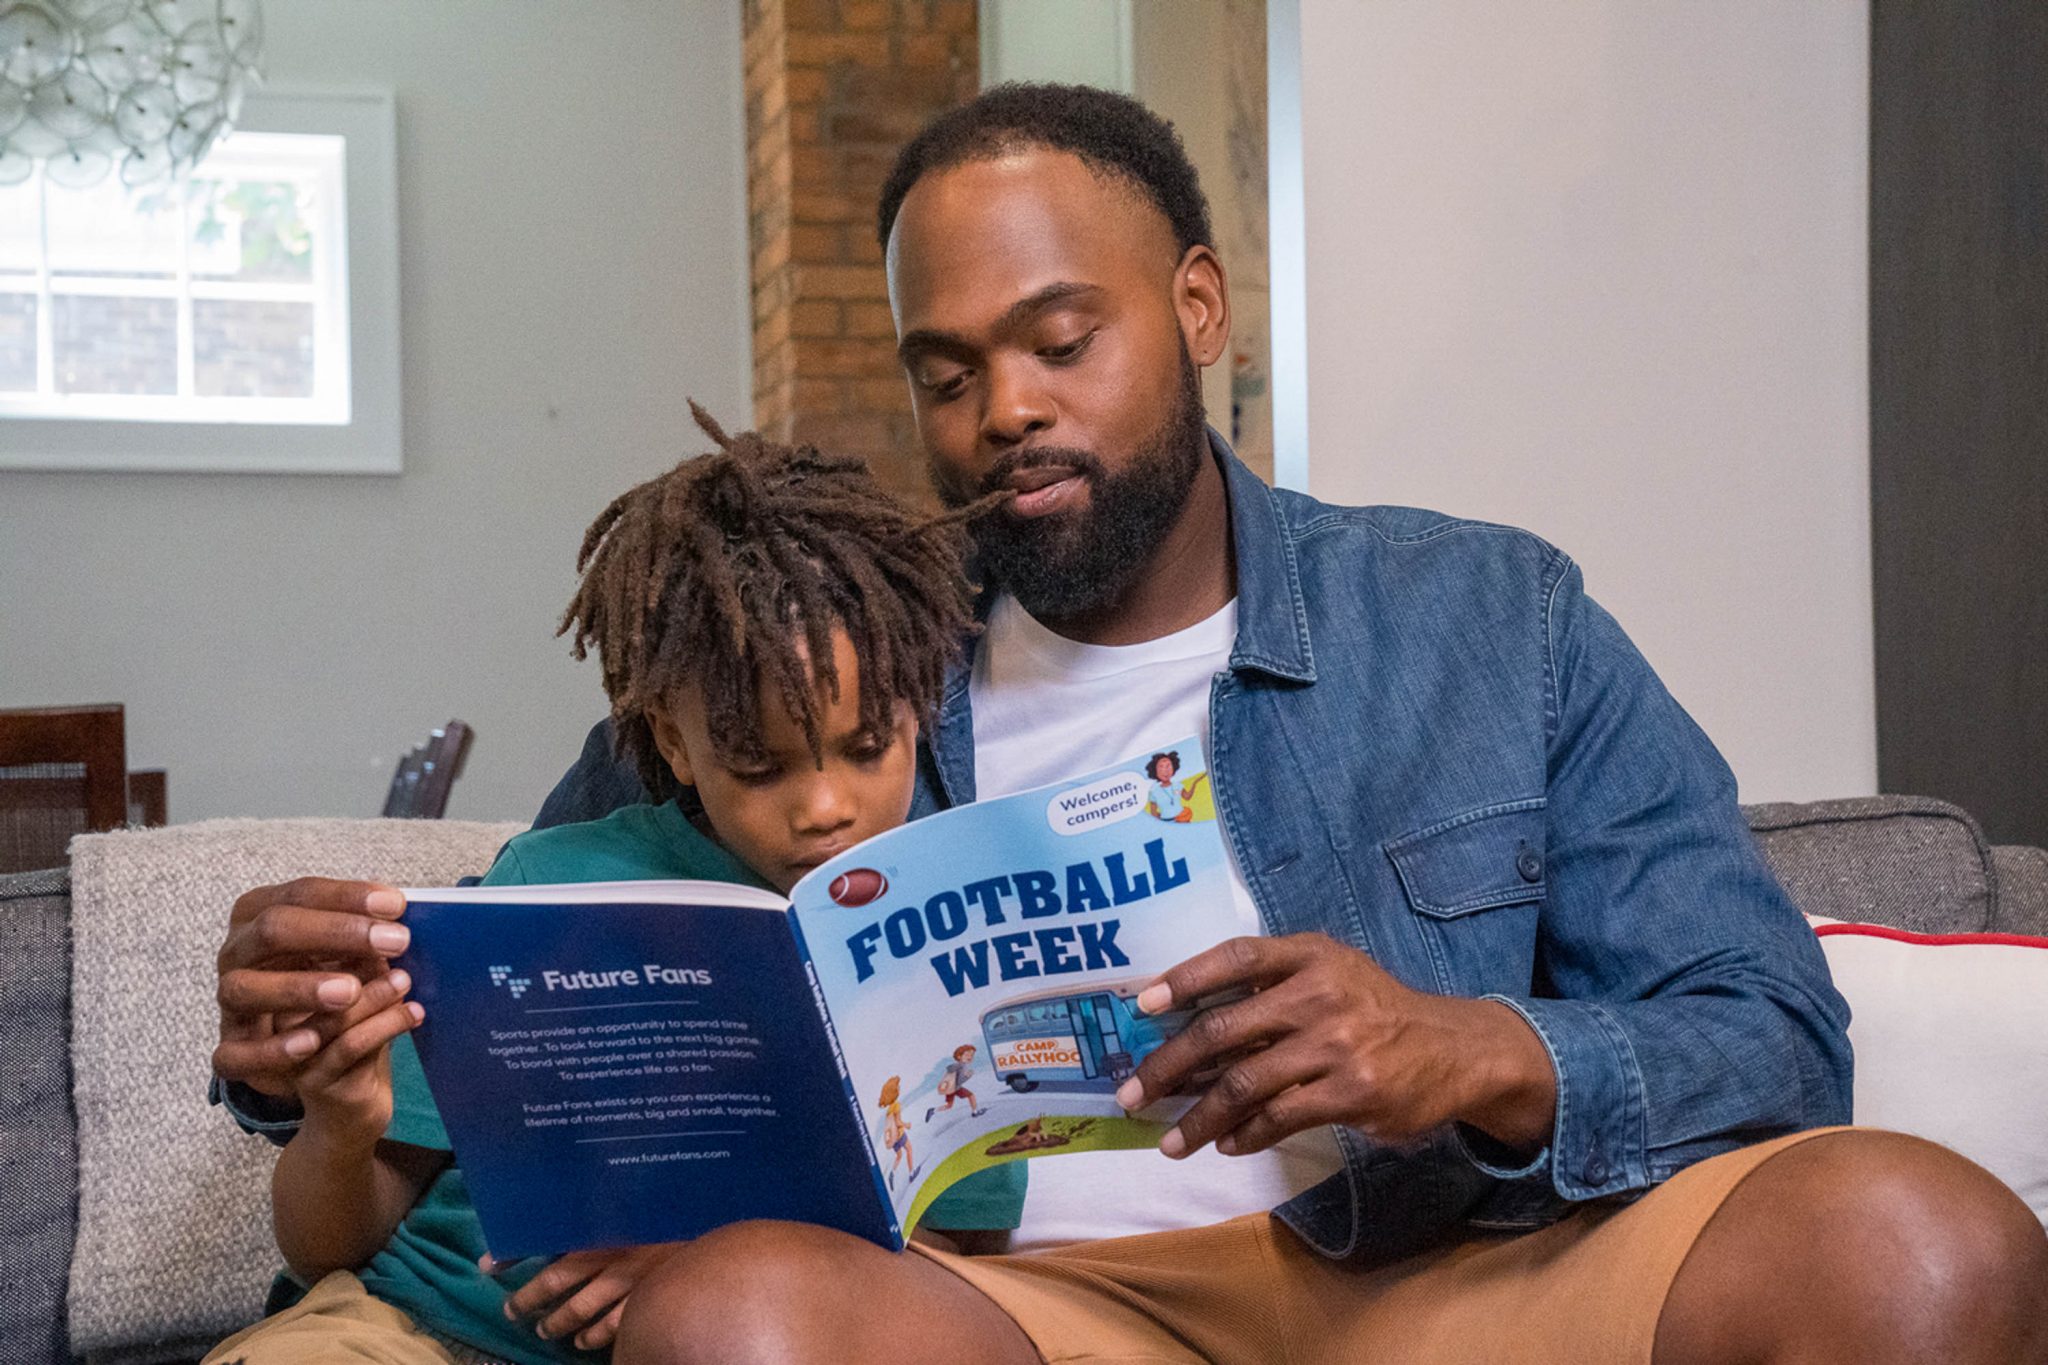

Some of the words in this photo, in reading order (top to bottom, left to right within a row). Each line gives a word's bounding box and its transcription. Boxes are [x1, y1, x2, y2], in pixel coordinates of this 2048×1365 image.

[1060, 779, 1138, 813] Welcome,
[1067, 795, 1139, 826] campers!
[846, 838, 1191, 984] FOOTBALL
[931, 920, 1130, 997] WEEK
[543, 968, 639, 991] Future
[643, 965, 712, 985] Fans
[490, 1029, 529, 1041] Sports
[532, 1027, 575, 1038] provide
[578, 1026, 594, 1034] an
[596, 1020, 666, 1035] opportunity
[668, 1020, 680, 1028] to
[683, 1020, 719, 1030] spend
[721, 1020, 747, 1030] time
[544, 1042, 558, 1051] To
[561, 1041, 585, 1050] look
[588, 1036, 636, 1048] forward
[639, 1036, 650, 1045] to
[653, 1035, 673, 1044] the
[676, 1034, 701, 1043] next
[703, 1033, 723, 1045] big
[1017, 1041, 1056, 1051] CAMP
[506, 1060, 519, 1069] To
[521, 1058, 552, 1068] bond
[555, 1056, 580, 1067] with
[584, 1054, 624, 1066] people
[627, 1051, 651, 1060] over
[666, 1048, 707, 1058] shared
[559, 1072, 573, 1080] To
[576, 1067, 641, 1080] experience
[644, 1066, 662, 1074] life
[682, 1065, 689, 1073] a
[523, 1102, 561, 1112] Future
[564, 1100, 592, 1110] Fans
[595, 1097, 627, 1107] exists
[646, 1095, 667, 1105] you
[670, 1094, 693, 1102] can
[696, 1092, 760, 1102] experience
[525, 1116, 568, 1127] lifetime
[570, 1115, 582, 1124] of
[645, 1109, 665, 1119] big
[667, 1107, 690, 1117] and
[609, 1149, 730, 1166] www.futurefans.com
